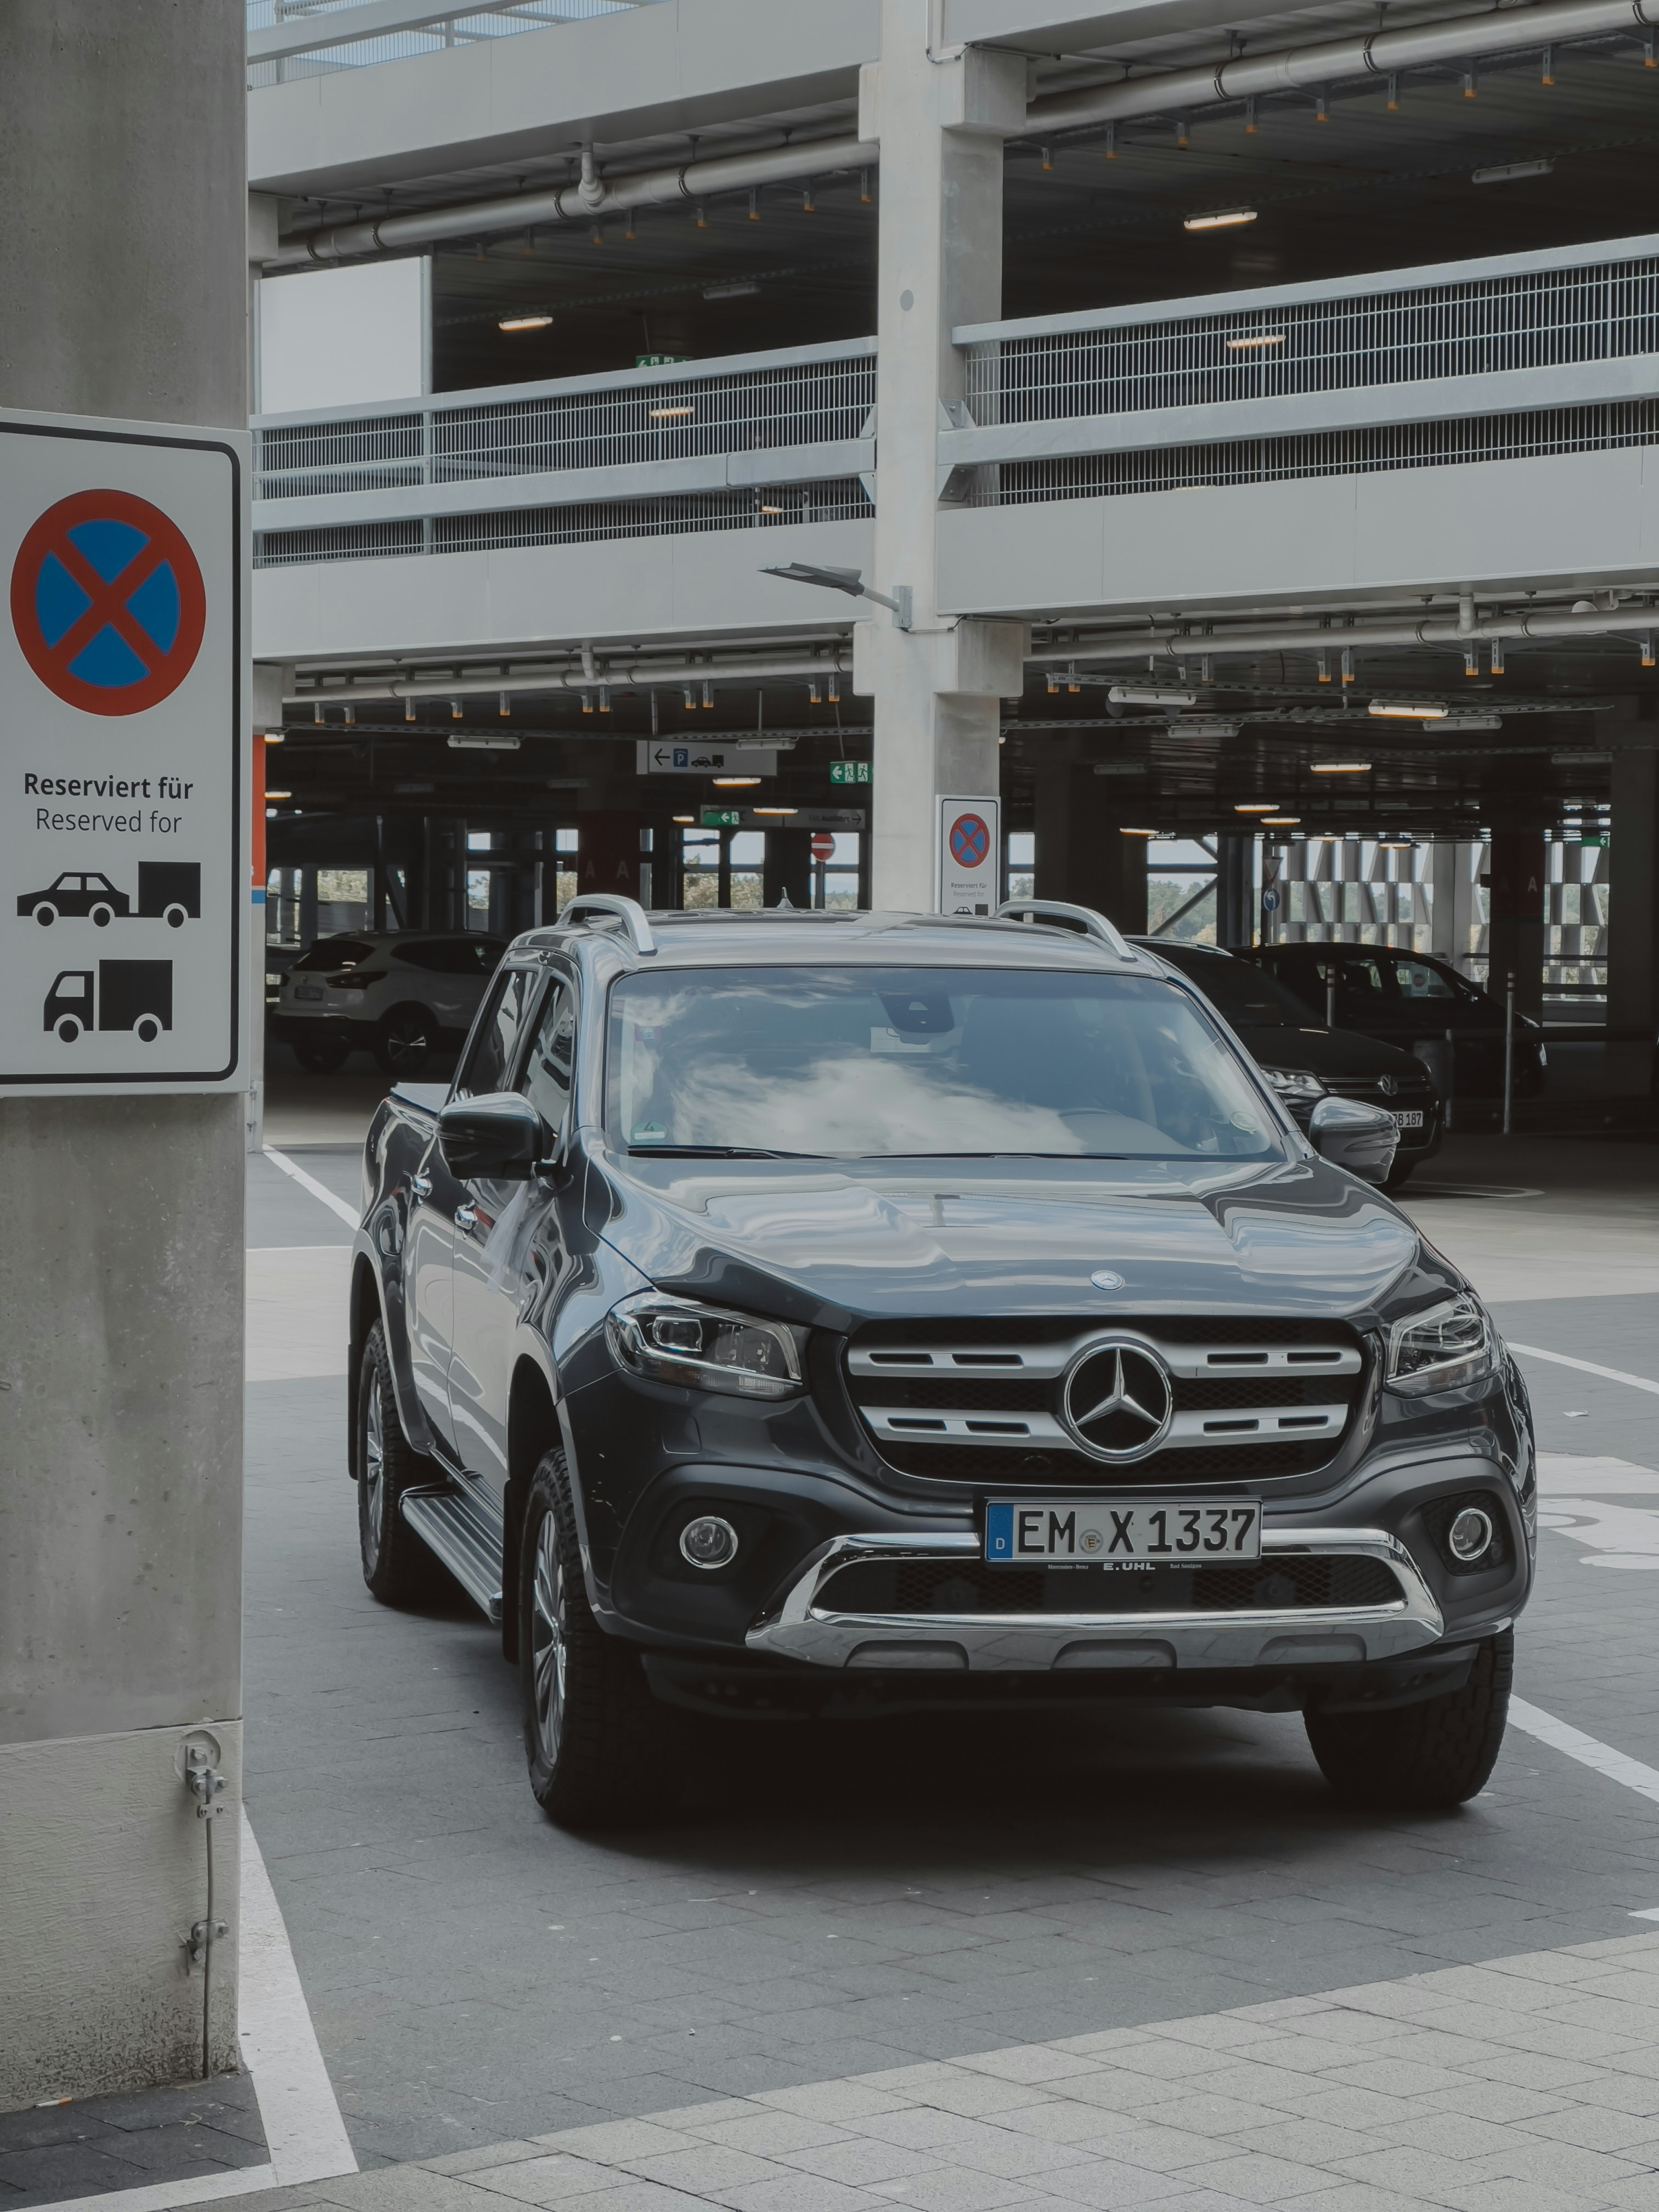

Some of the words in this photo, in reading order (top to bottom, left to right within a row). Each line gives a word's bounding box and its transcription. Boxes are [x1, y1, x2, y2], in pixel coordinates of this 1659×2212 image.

[677, 753, 684, 765] P
[24, 772, 151, 799] Reserviert
[158, 776, 194, 800] für
[36, 808, 142, 833] Reserved
[149, 810, 182, 833] for
[616, 860, 629, 879] A
[1527, 876, 1538, 893] A
[1404, 1113, 1421, 1126] 187
[1018, 1510, 1076, 1553] EM
[1108, 1510, 1134, 1553] X
[1148, 1509, 1255, 1553] 1337
[996, 1538, 1005, 1550] D
[1103, 1562, 1156, 1571] E.UHL
